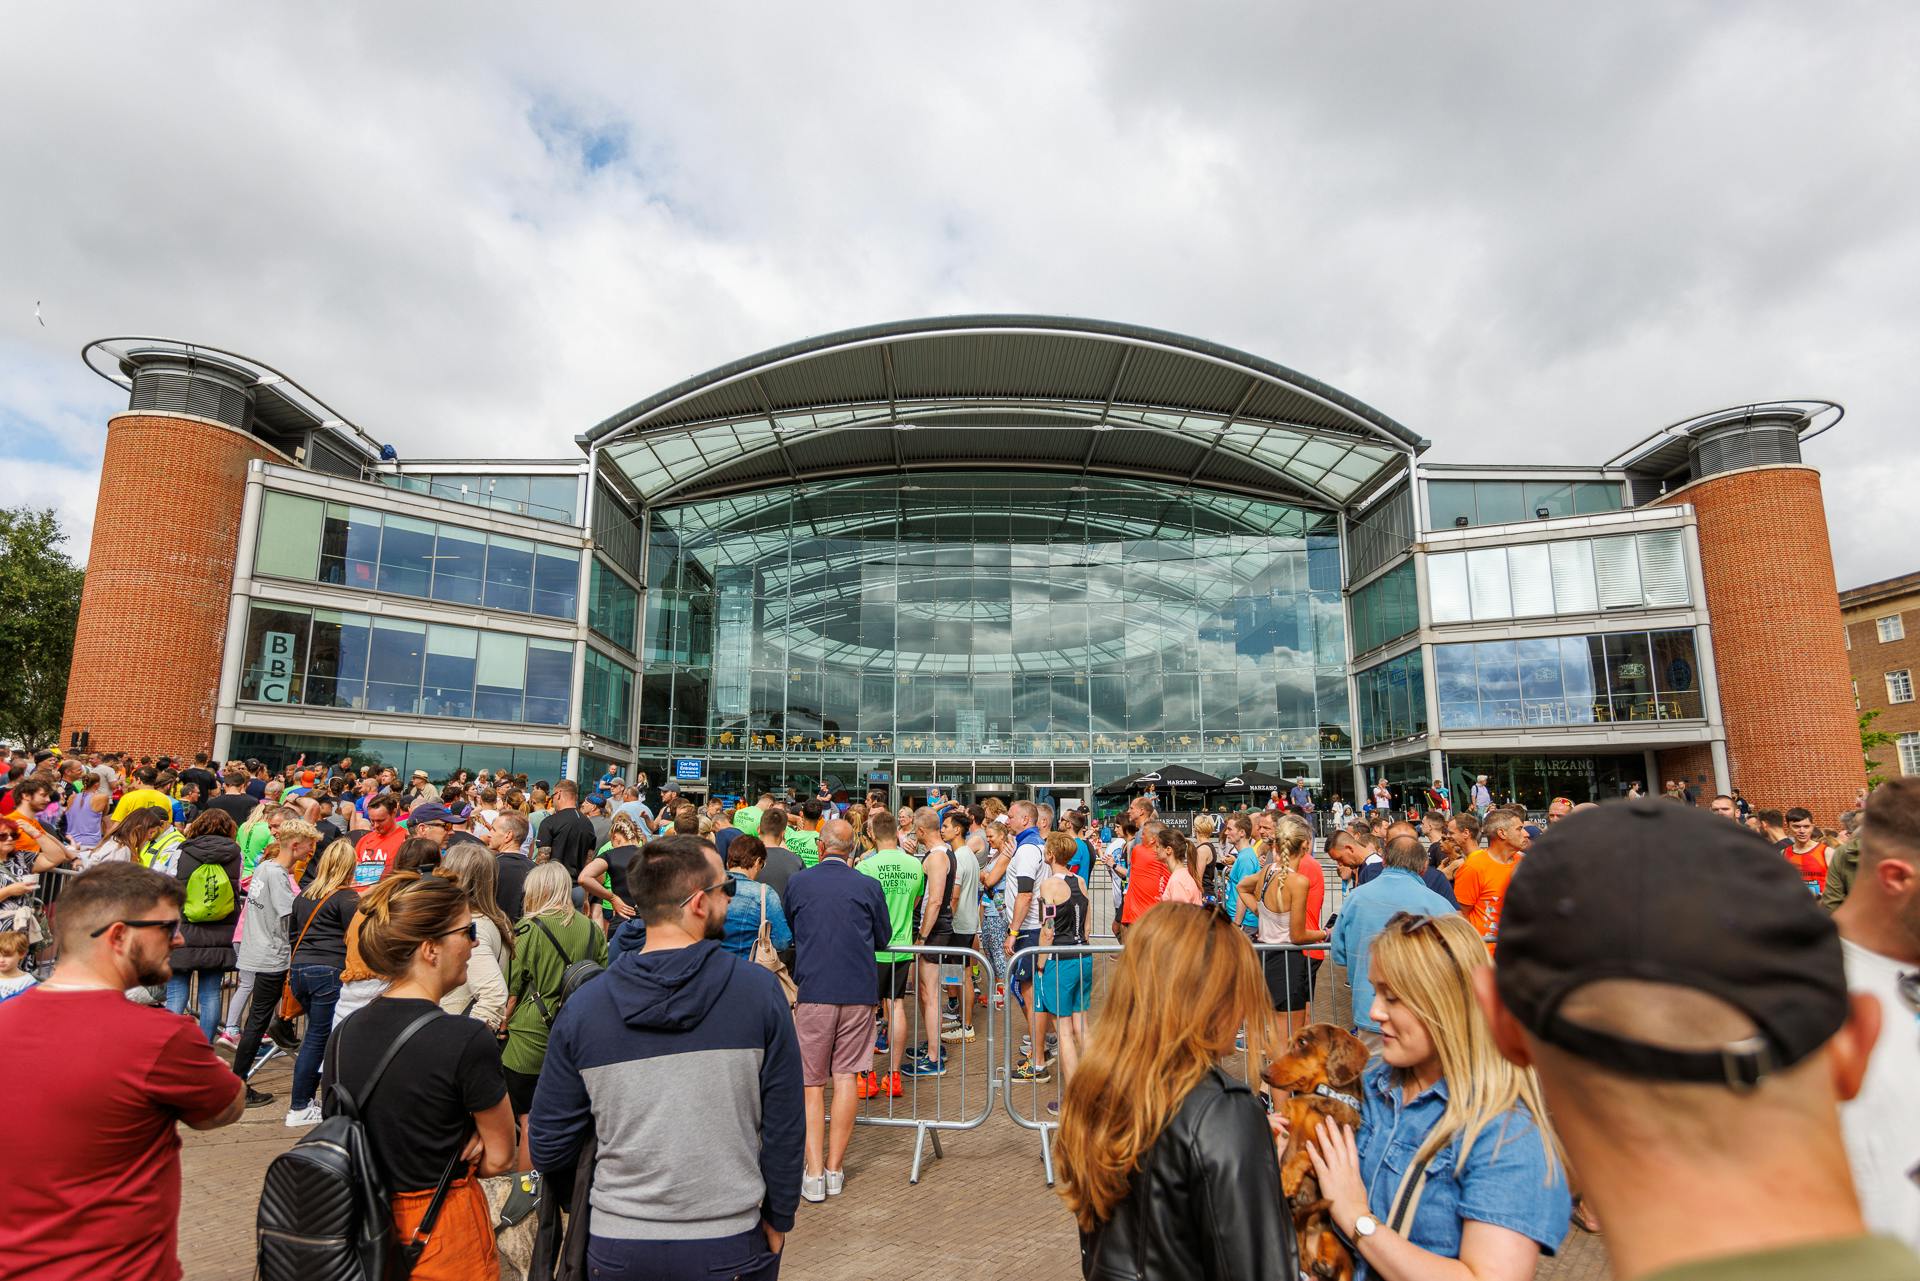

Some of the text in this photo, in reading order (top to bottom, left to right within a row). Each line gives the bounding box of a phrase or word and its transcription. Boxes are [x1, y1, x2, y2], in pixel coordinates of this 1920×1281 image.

[263, 635, 288, 702] BBC
[1534, 759, 1594, 770] MARZANO
[878, 871, 918, 880] CHANGING
[883, 879, 899, 887] IVES
